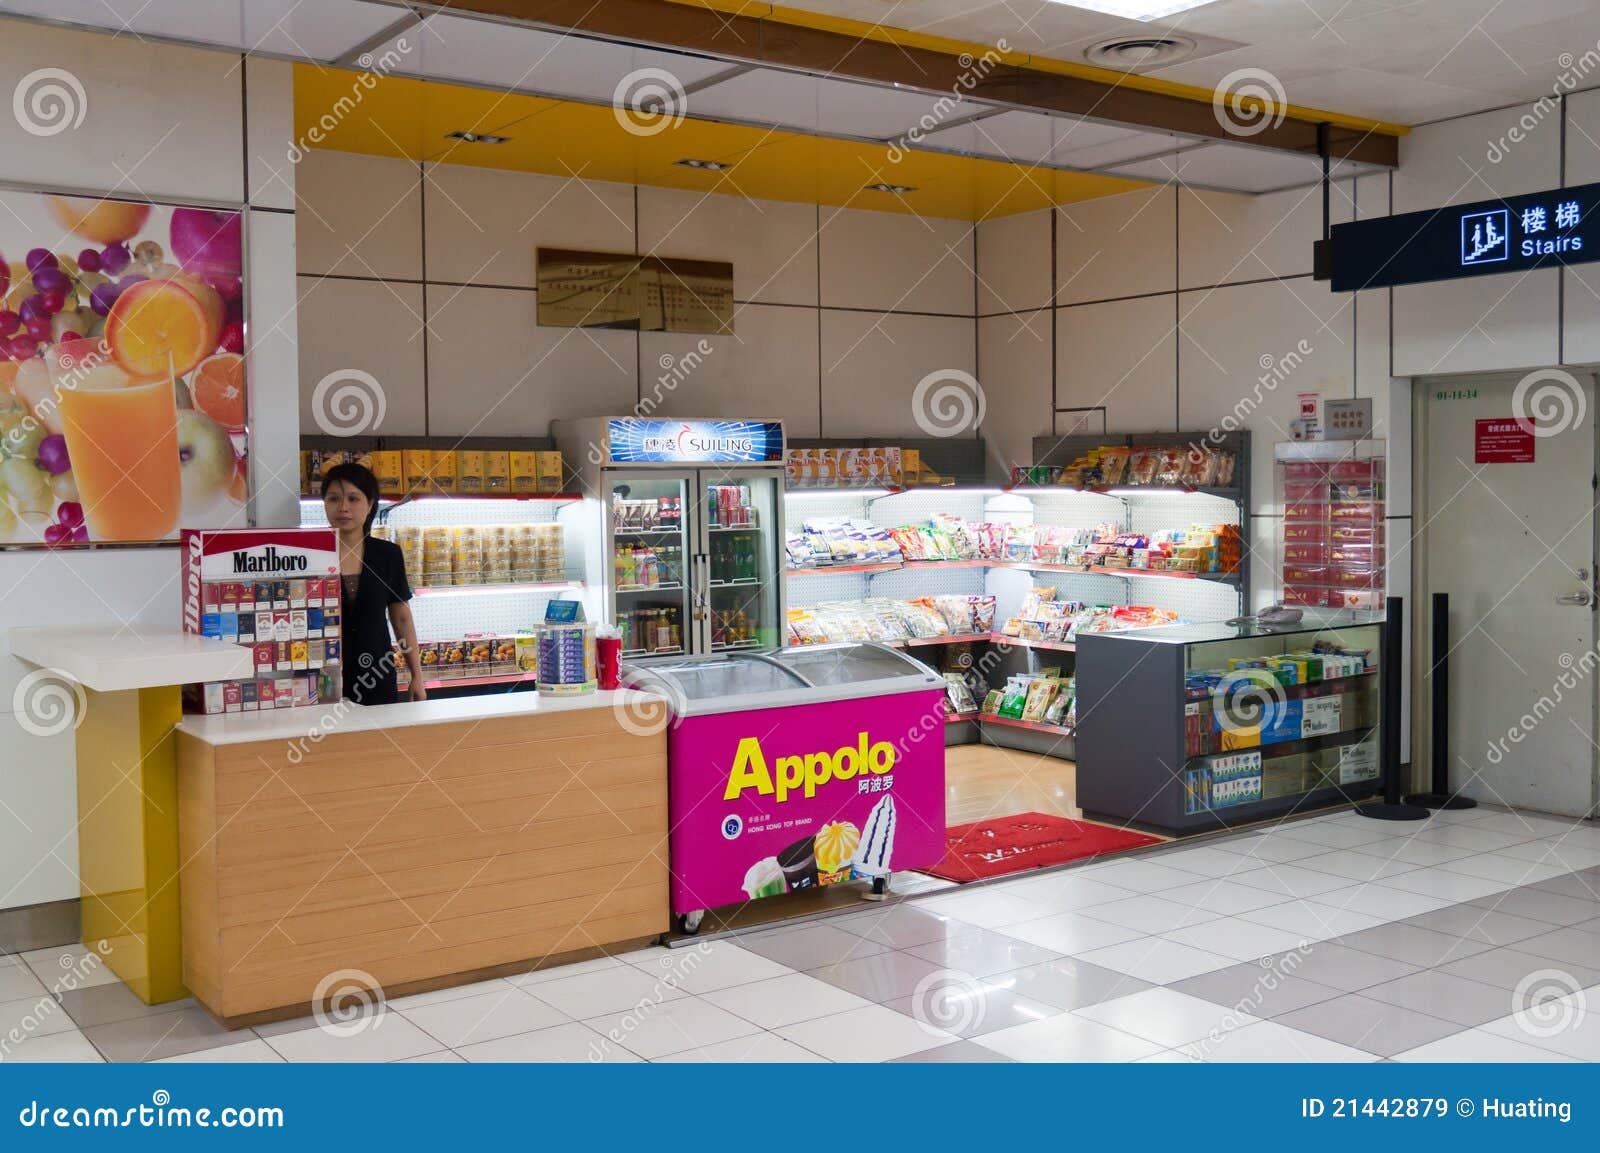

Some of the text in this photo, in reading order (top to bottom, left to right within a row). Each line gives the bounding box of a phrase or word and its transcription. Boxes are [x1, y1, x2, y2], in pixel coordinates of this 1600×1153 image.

[1521, 201, 1581, 234] 楼梯
[1521, 235, 1583, 257] Stairs
[690, 438, 752, 452] SUILING
[233, 546, 308, 574] Marlboro
[723, 731, 896, 803] Appolo
[857, 775, 895, 795] 阿波罗
[747, 817, 813, 834] HONG KONG TOP BRAND
